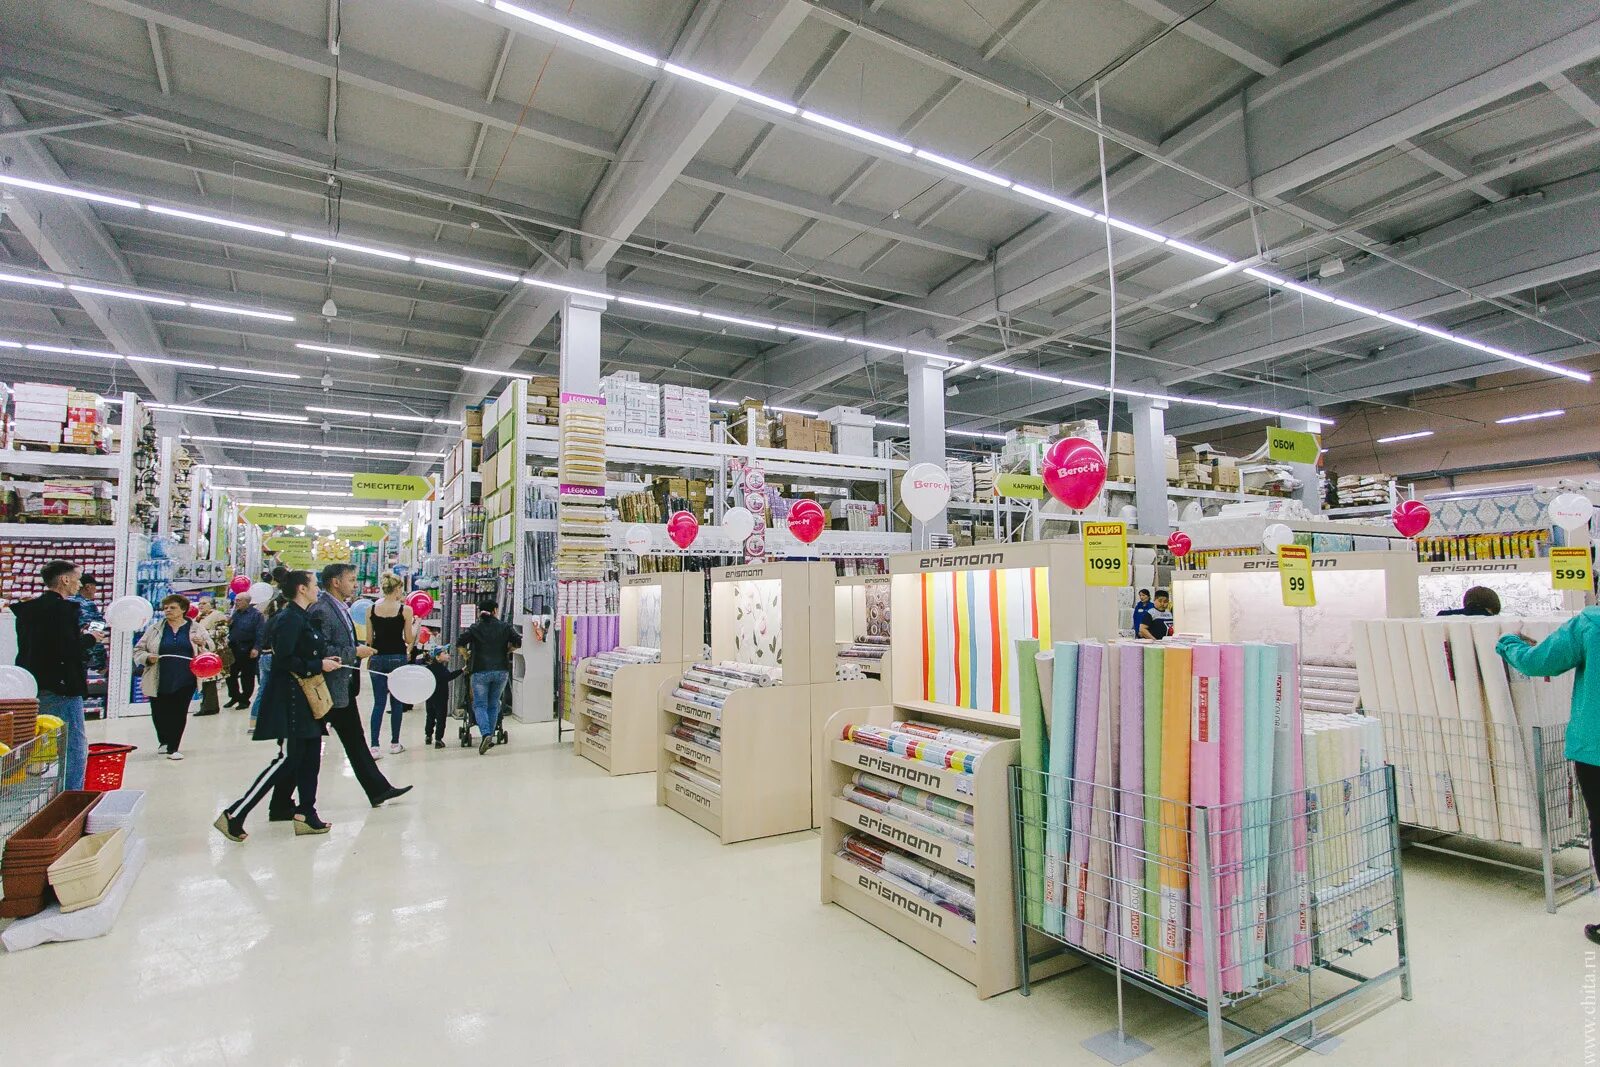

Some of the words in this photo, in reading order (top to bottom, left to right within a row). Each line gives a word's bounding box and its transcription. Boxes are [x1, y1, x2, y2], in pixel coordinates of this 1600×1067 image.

[568, 395, 600, 405] LEGRAND
[606, 425, 623, 433] KLEO
[627, 427, 643, 435] KLEO
[1273, 439, 1295, 451] ОБОИ
[356, 482, 415, 491] СМЕСИТЕЛИ
[567, 487, 598, 495] LEGRAND
[257, 512, 304, 520] ЭЛЕКТРИКА
[1088, 525, 1121, 535] АКЦИЯ
[919, 552, 1004, 569] erismann
[1089, 558, 1121, 570] 1099
[1243, 558, 1337, 569] erisnn
[724, 568, 763, 578] erismann
[1430, 563, 1518, 573] erismann
[1556, 569, 1586, 579] 599
[1289, 577, 1305, 591] 99
[676, 703, 712, 720] erismann
[675, 743, 711, 764] erismann
[858, 754, 941, 789] erismann
[675, 783, 711, 808] erismann
[858, 813, 942, 858] erismann
[858, 874, 943, 928] erismann
